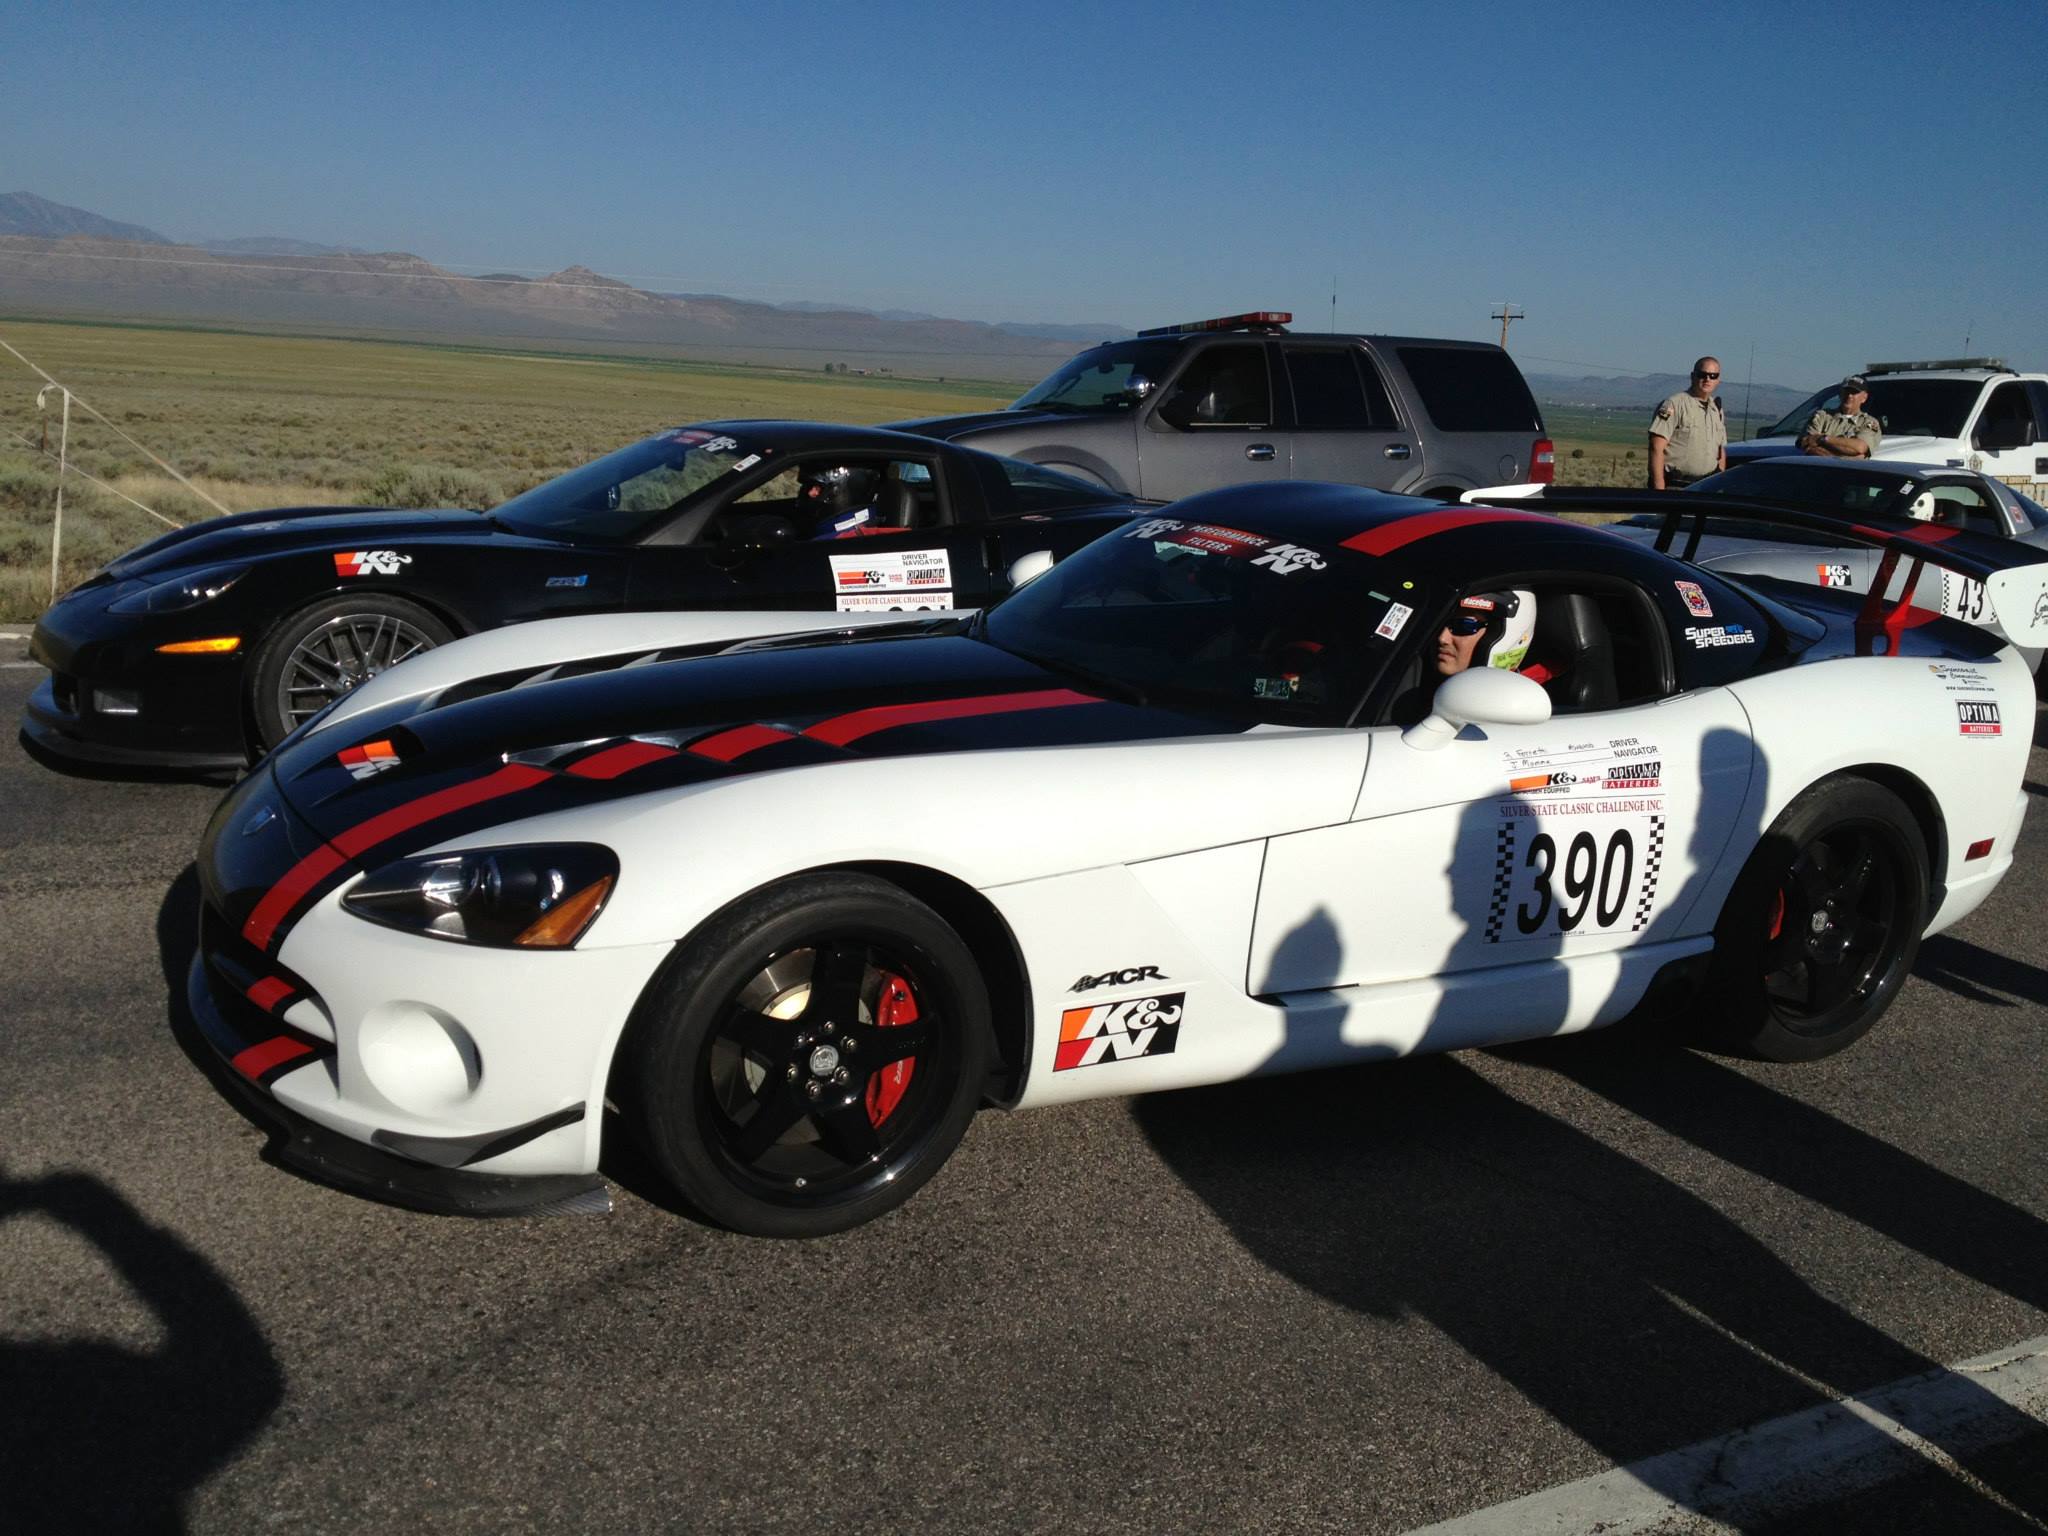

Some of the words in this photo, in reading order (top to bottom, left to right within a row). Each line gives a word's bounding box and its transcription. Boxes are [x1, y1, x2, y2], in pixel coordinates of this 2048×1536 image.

[1123, 519, 1184, 539] K&N
[1189, 525, 1270, 547] PERFORMANCE
[1186, 537, 1233, 551] FILTERS
[351, 551, 412, 575] K&N
[1250, 543, 1327, 574] K&N
[907, 568, 945, 579] OPTIMA
[1826, 565, 1850, 586] K&N
[904, 596, 936, 604] CHALLENGE
[1957, 577, 1984, 620] 43
[1684, 627, 1725, 640] SUPER
[1695, 633, 1755, 648] SPEEDERS
[1959, 704, 2000, 722] OPTIMA
[1969, 725, 1994, 733] BATTERIES
[1609, 738, 1639, 748] DRIVER
[1613, 746, 1658, 759] NAVIGATOR
[1607, 762, 1661, 779] OPTIMA
[1601, 778, 1661, 789] BATTERIES
[1500, 805, 1530, 818] SILVER
[1531, 804, 1558, 817] STATE
[1559, 802, 1594, 815] CLASSIC
[1596, 800, 1645, 814] CHALLENGE
[1646, 799, 1664, 811] INC.
[1517, 828, 1634, 934] 390
[1096, 965, 1171, 986] ACR
[1076, 998, 1182, 1067] K&N
